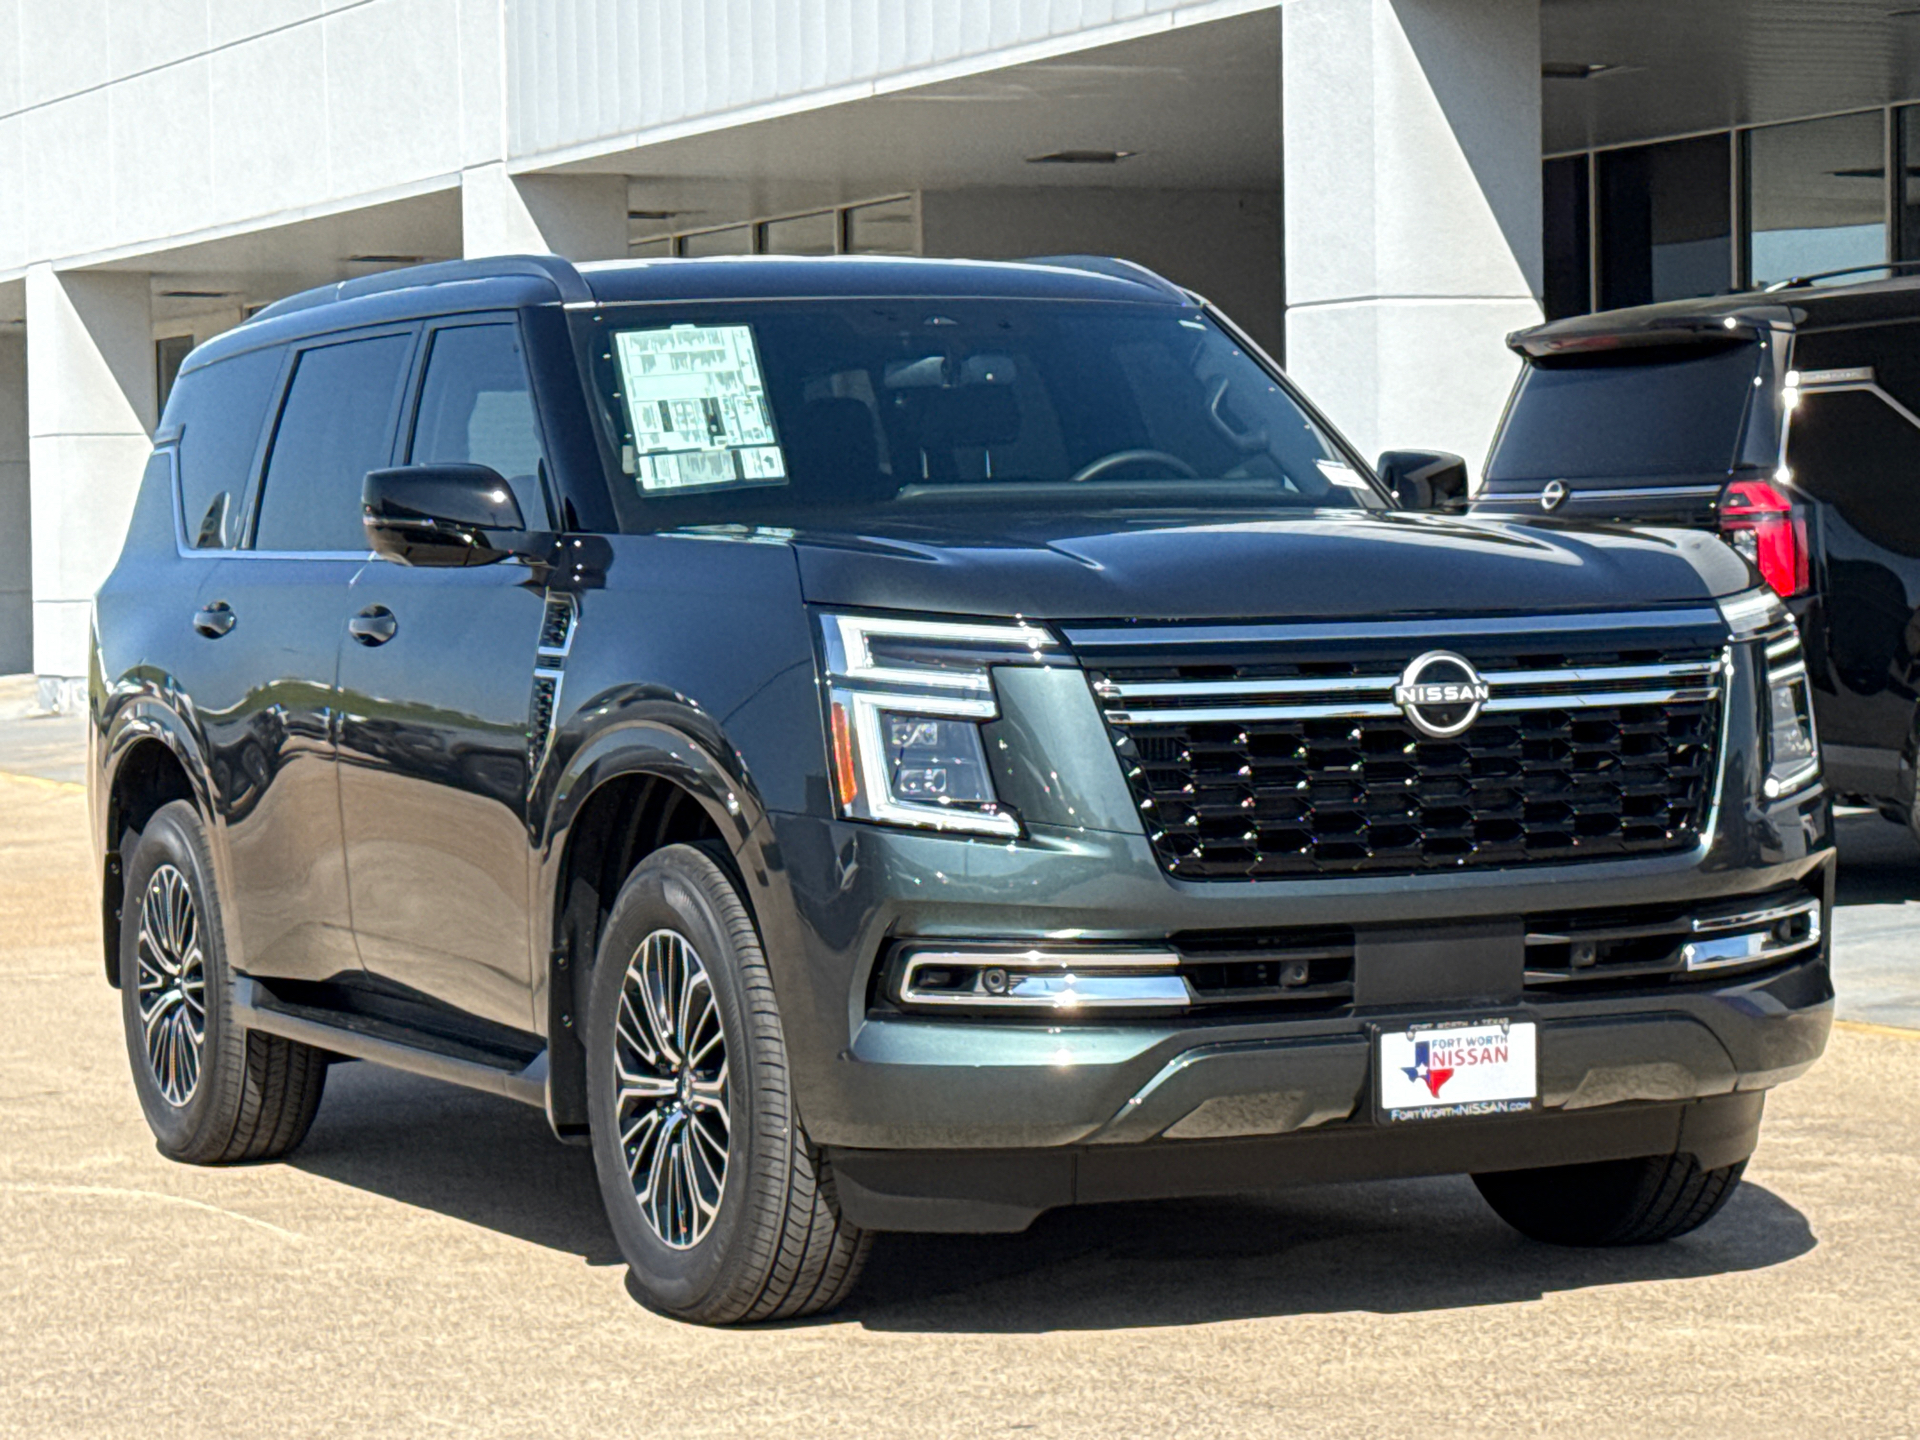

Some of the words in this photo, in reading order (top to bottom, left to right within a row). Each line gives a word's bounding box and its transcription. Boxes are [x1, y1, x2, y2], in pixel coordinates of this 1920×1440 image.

[1399, 685, 1489, 702] NISSAN
[1432, 1037, 1462, 1049] FORT
[1466, 1034, 1508, 1047] WORTH
[1432, 1045, 1508, 1067] NISSAN
